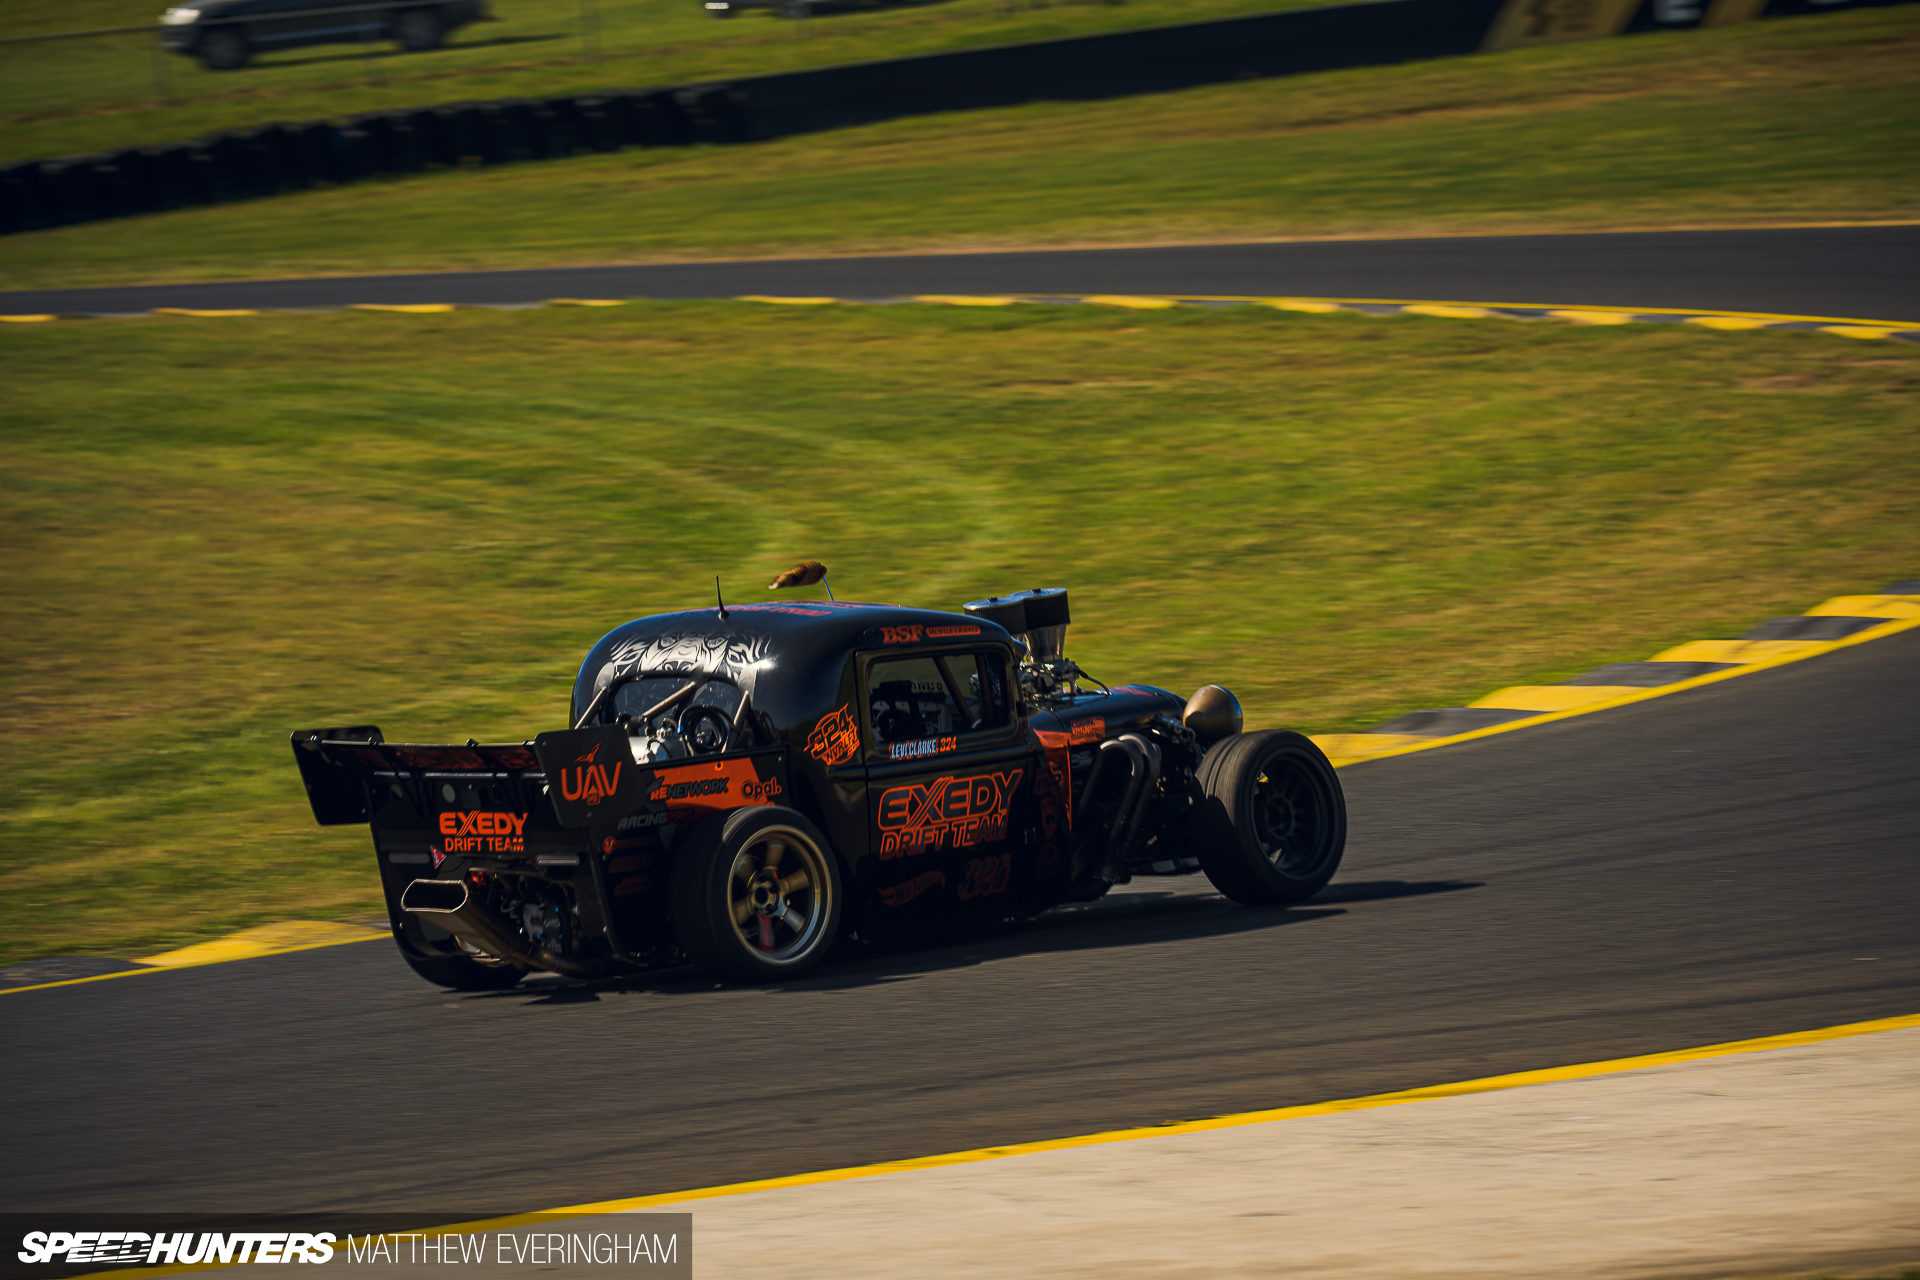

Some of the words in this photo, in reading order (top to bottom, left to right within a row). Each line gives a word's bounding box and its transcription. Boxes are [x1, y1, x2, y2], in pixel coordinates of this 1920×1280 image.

[880, 624, 924, 645] BSF
[891, 742, 908, 759] LEVI
[908, 739, 937, 757] CLARKE
[940, 736, 957, 753] 324
[561, 761, 622, 802] UAV
[878, 768, 1024, 831] EXEDY
[439, 810, 528, 837] EXEDY
[879, 823, 949, 860] DRIFT
[952, 812, 1008, 848] TEAM
[444, 837, 482, 852] DRIFT
[486, 837, 524, 852] TEAM
[958, 852, 1012, 900] 324
